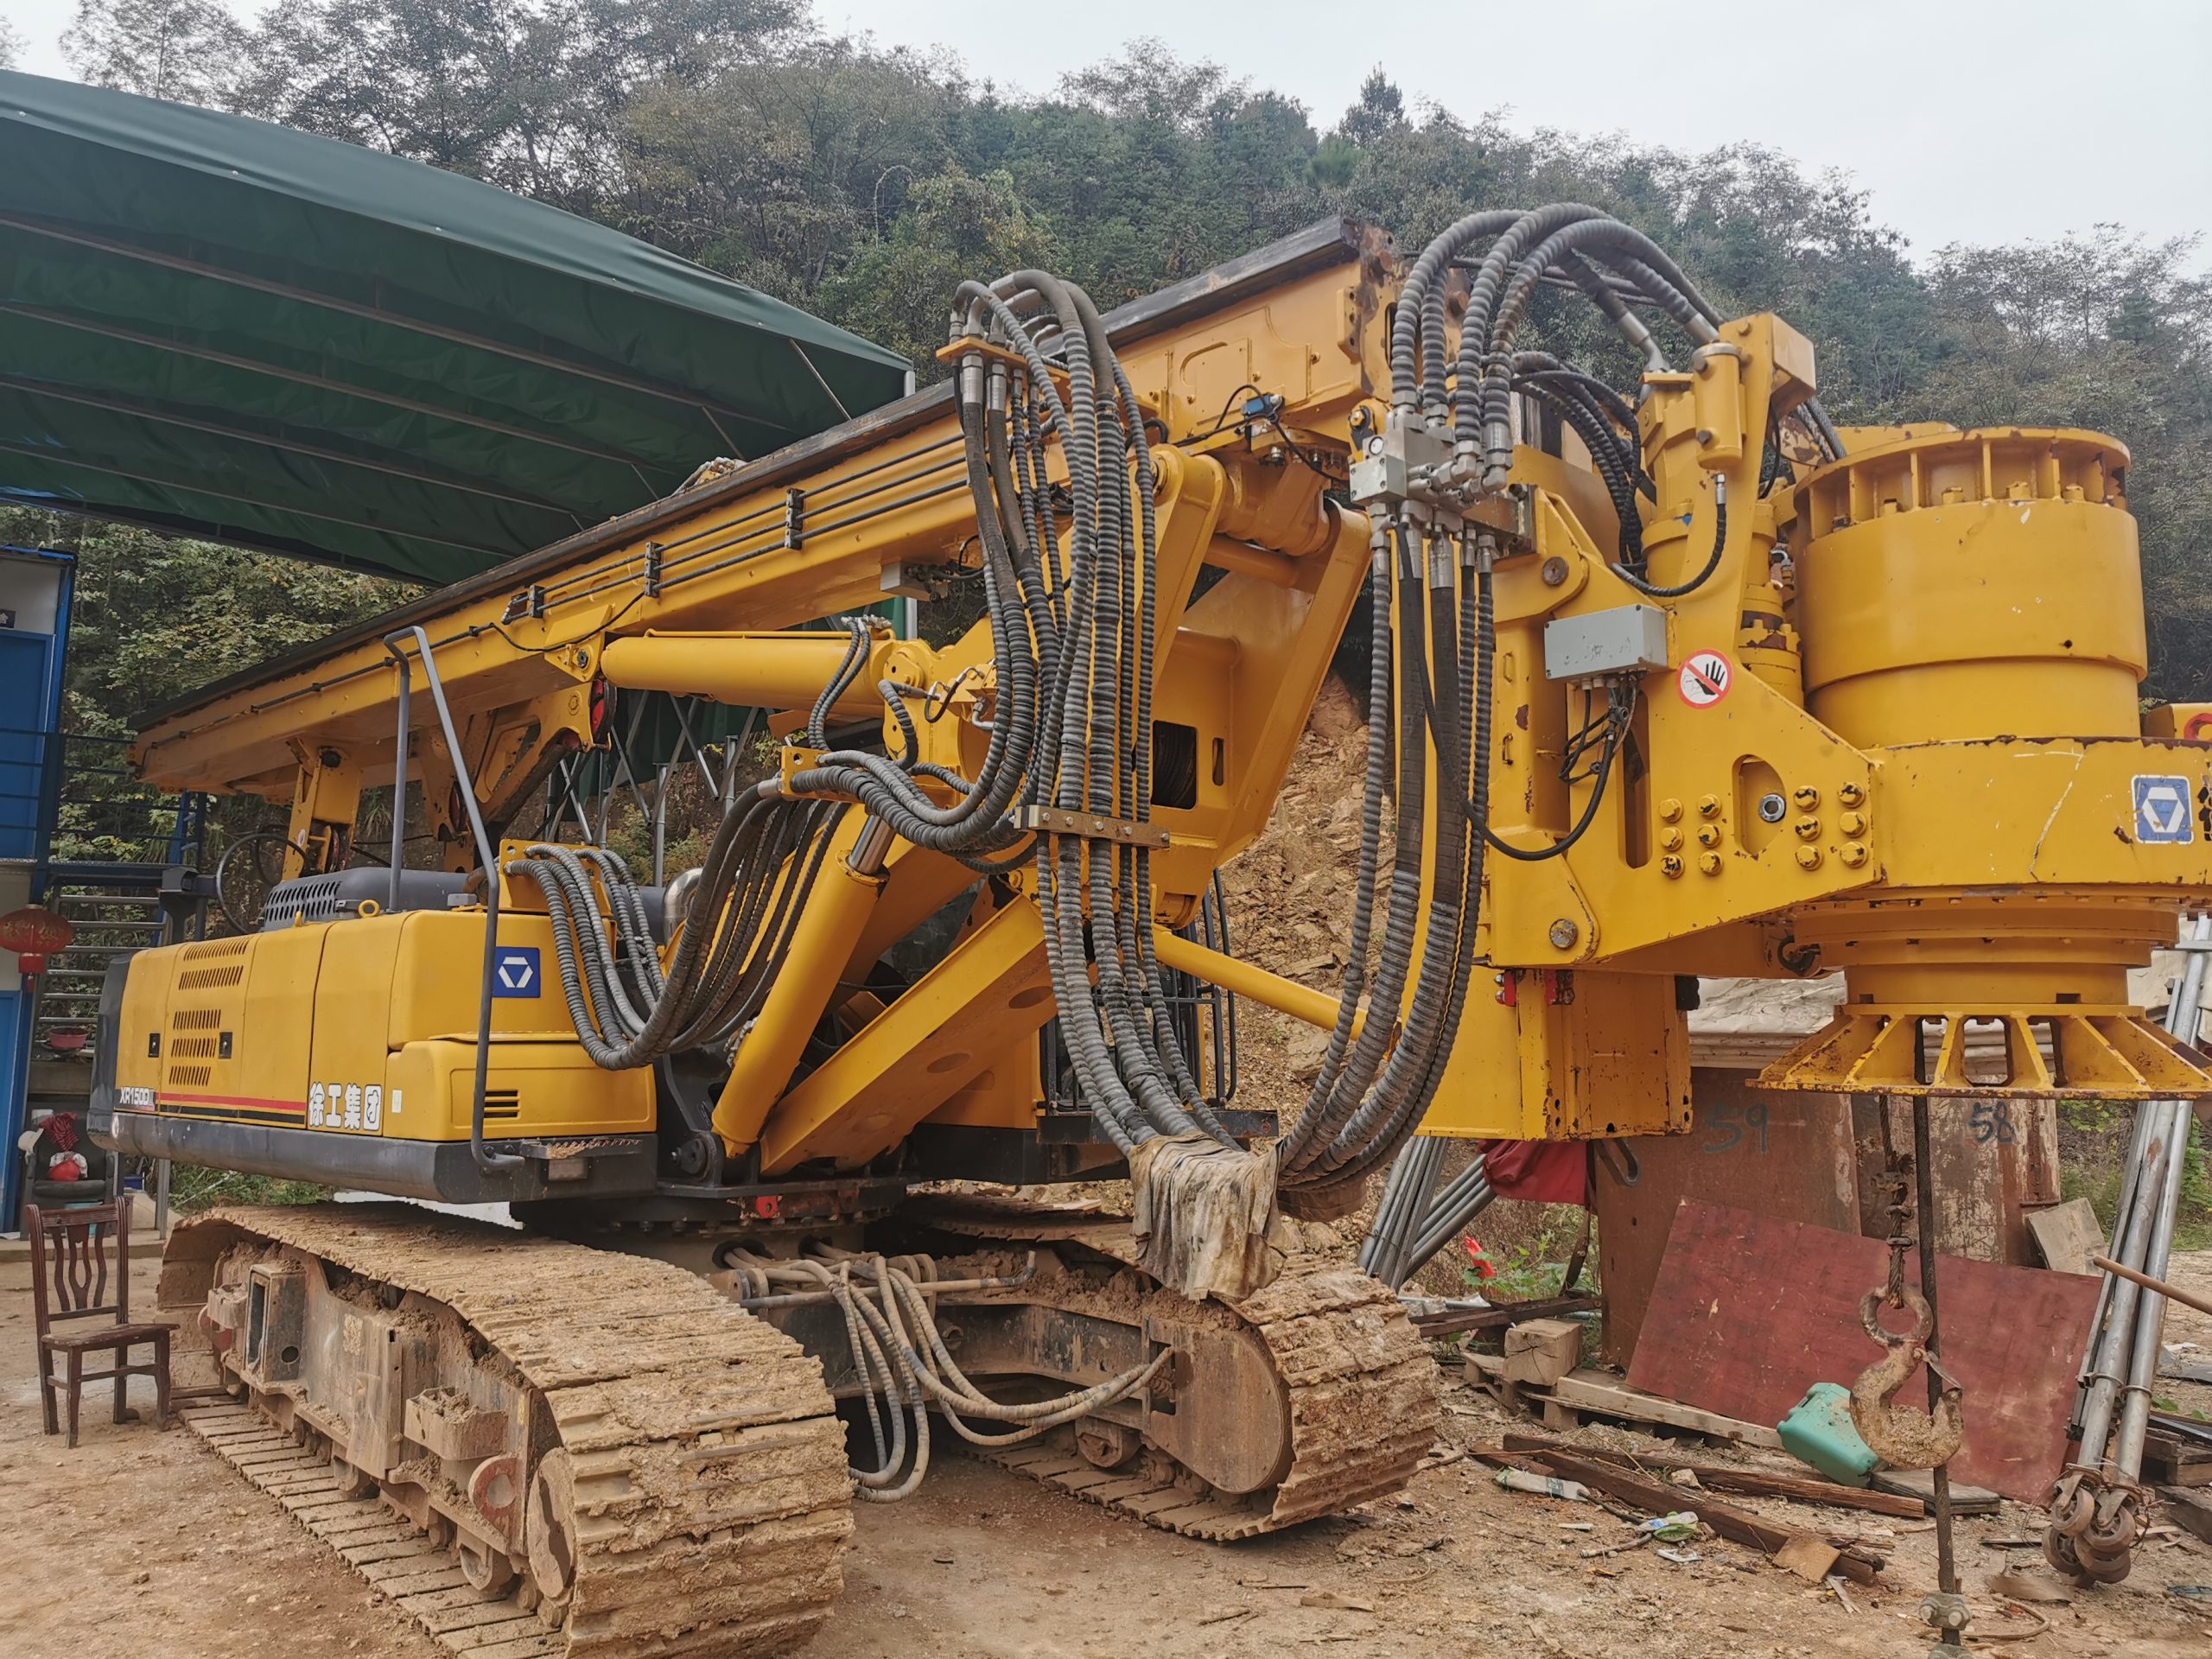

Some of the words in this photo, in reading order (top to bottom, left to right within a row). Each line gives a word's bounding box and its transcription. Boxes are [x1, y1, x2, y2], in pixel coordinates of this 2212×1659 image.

[309, 1082, 382, 1131] 徐工集团
[1703, 1102, 1769, 1154] 59
[1969, 1101, 2016, 1143] 58
